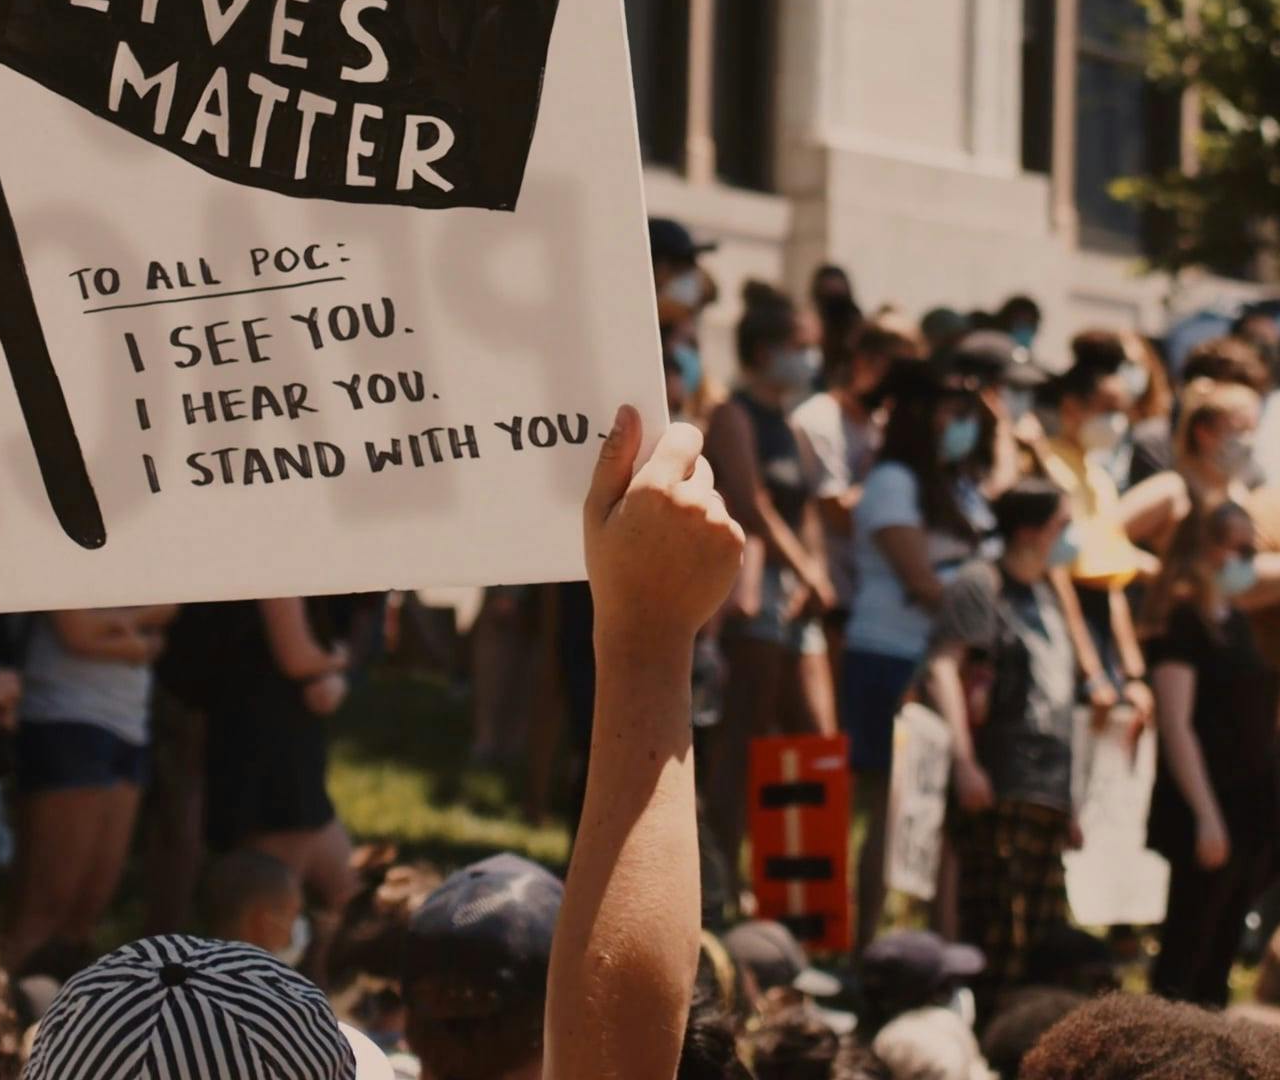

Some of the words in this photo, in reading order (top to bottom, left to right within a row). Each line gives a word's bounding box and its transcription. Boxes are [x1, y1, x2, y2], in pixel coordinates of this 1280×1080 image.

[109, 41, 454, 193] MATTER
[68, 266, 121, 300] TO
[146, 257, 222, 290] ALL
[249, 242, 351, 276] POC:
[124, 332, 145, 373] I
[169, 317, 274, 369] SEE
[290, 297, 415, 350] YOU.
[135, 398, 151, 430] I
[182, 382, 320, 425] HEAR
[332, 371, 440, 410] YOU.
[142, 454, 161, 494] I
[185, 441, 346, 486] STAND
[364, 425, 481, 473] WITH
